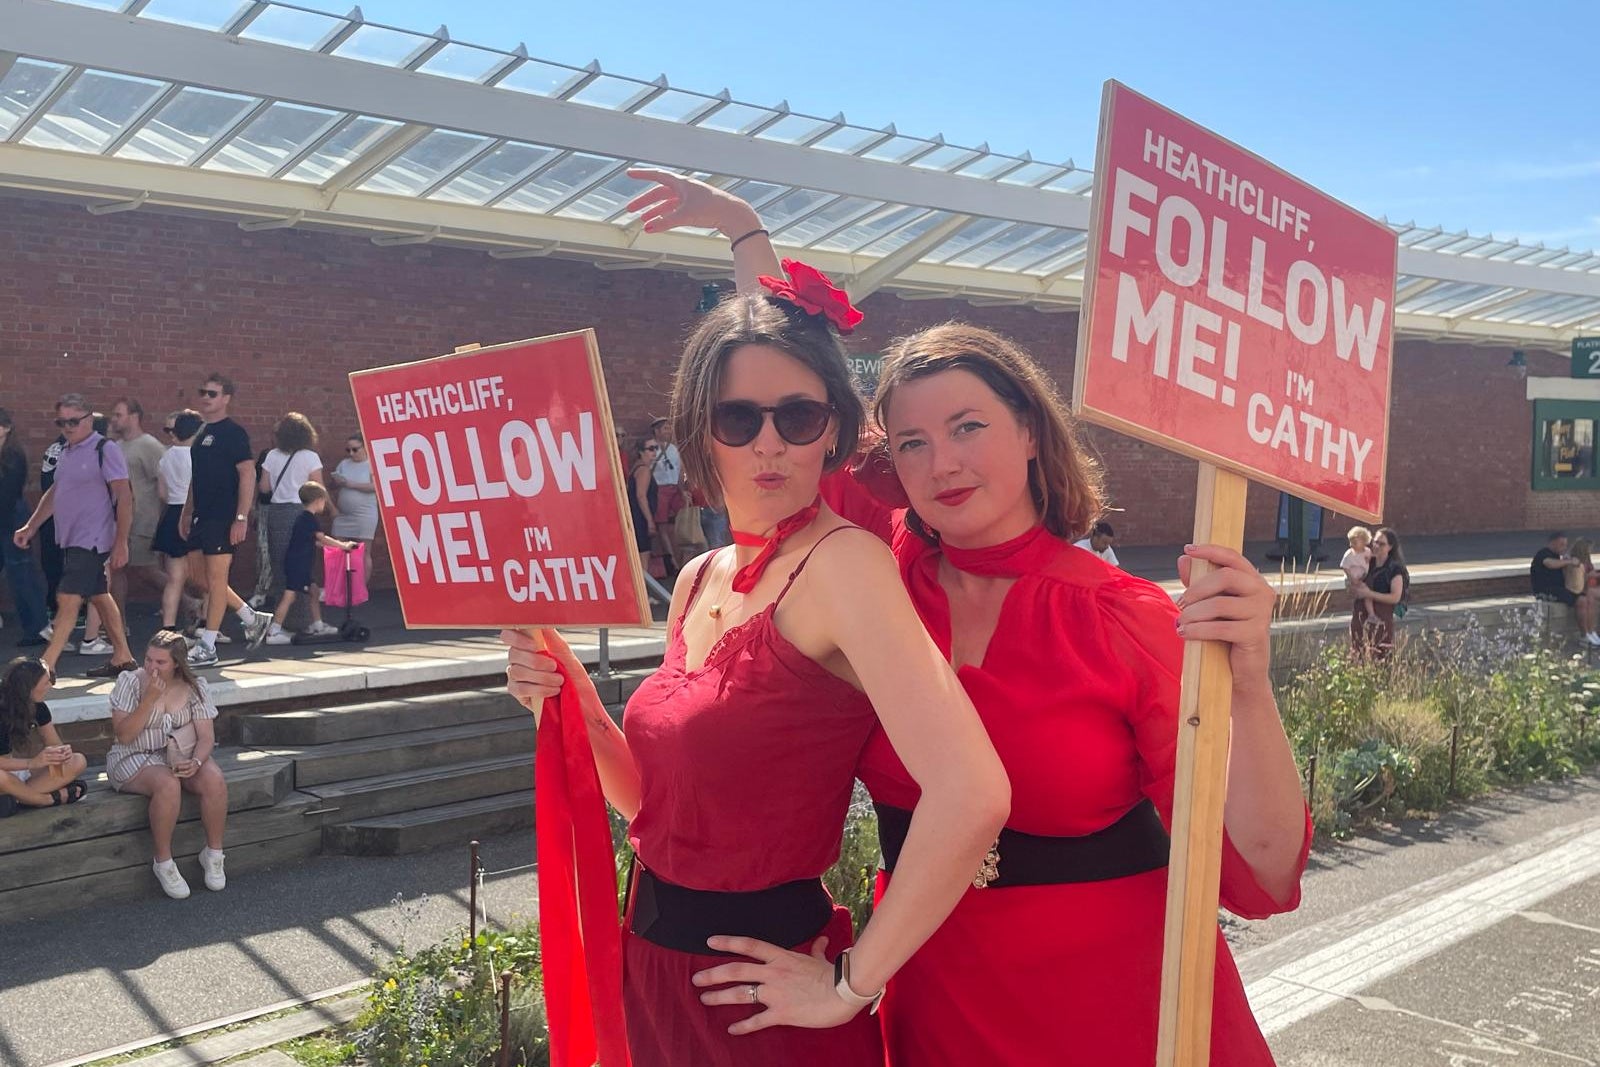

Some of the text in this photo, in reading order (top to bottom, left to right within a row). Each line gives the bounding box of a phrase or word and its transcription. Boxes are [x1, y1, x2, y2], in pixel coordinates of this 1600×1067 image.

[1143, 129, 1314, 252] HEATHCLIFF,
[1108, 167, 1386, 371] FOLLOW
[1112, 272, 1241, 407] ME!
[1588, 350, 1600, 374] 2
[376, 376, 513, 424] HEATHCLIFF,
[1286, 370, 1314, 406] I'M
[370, 411, 597, 507] FOLLOW
[1246, 392, 1373, 482] CATHY
[395, 511, 494, 584] ME!
[523, 526, 552, 552] I'M
[502, 555, 617, 603] CATHY
